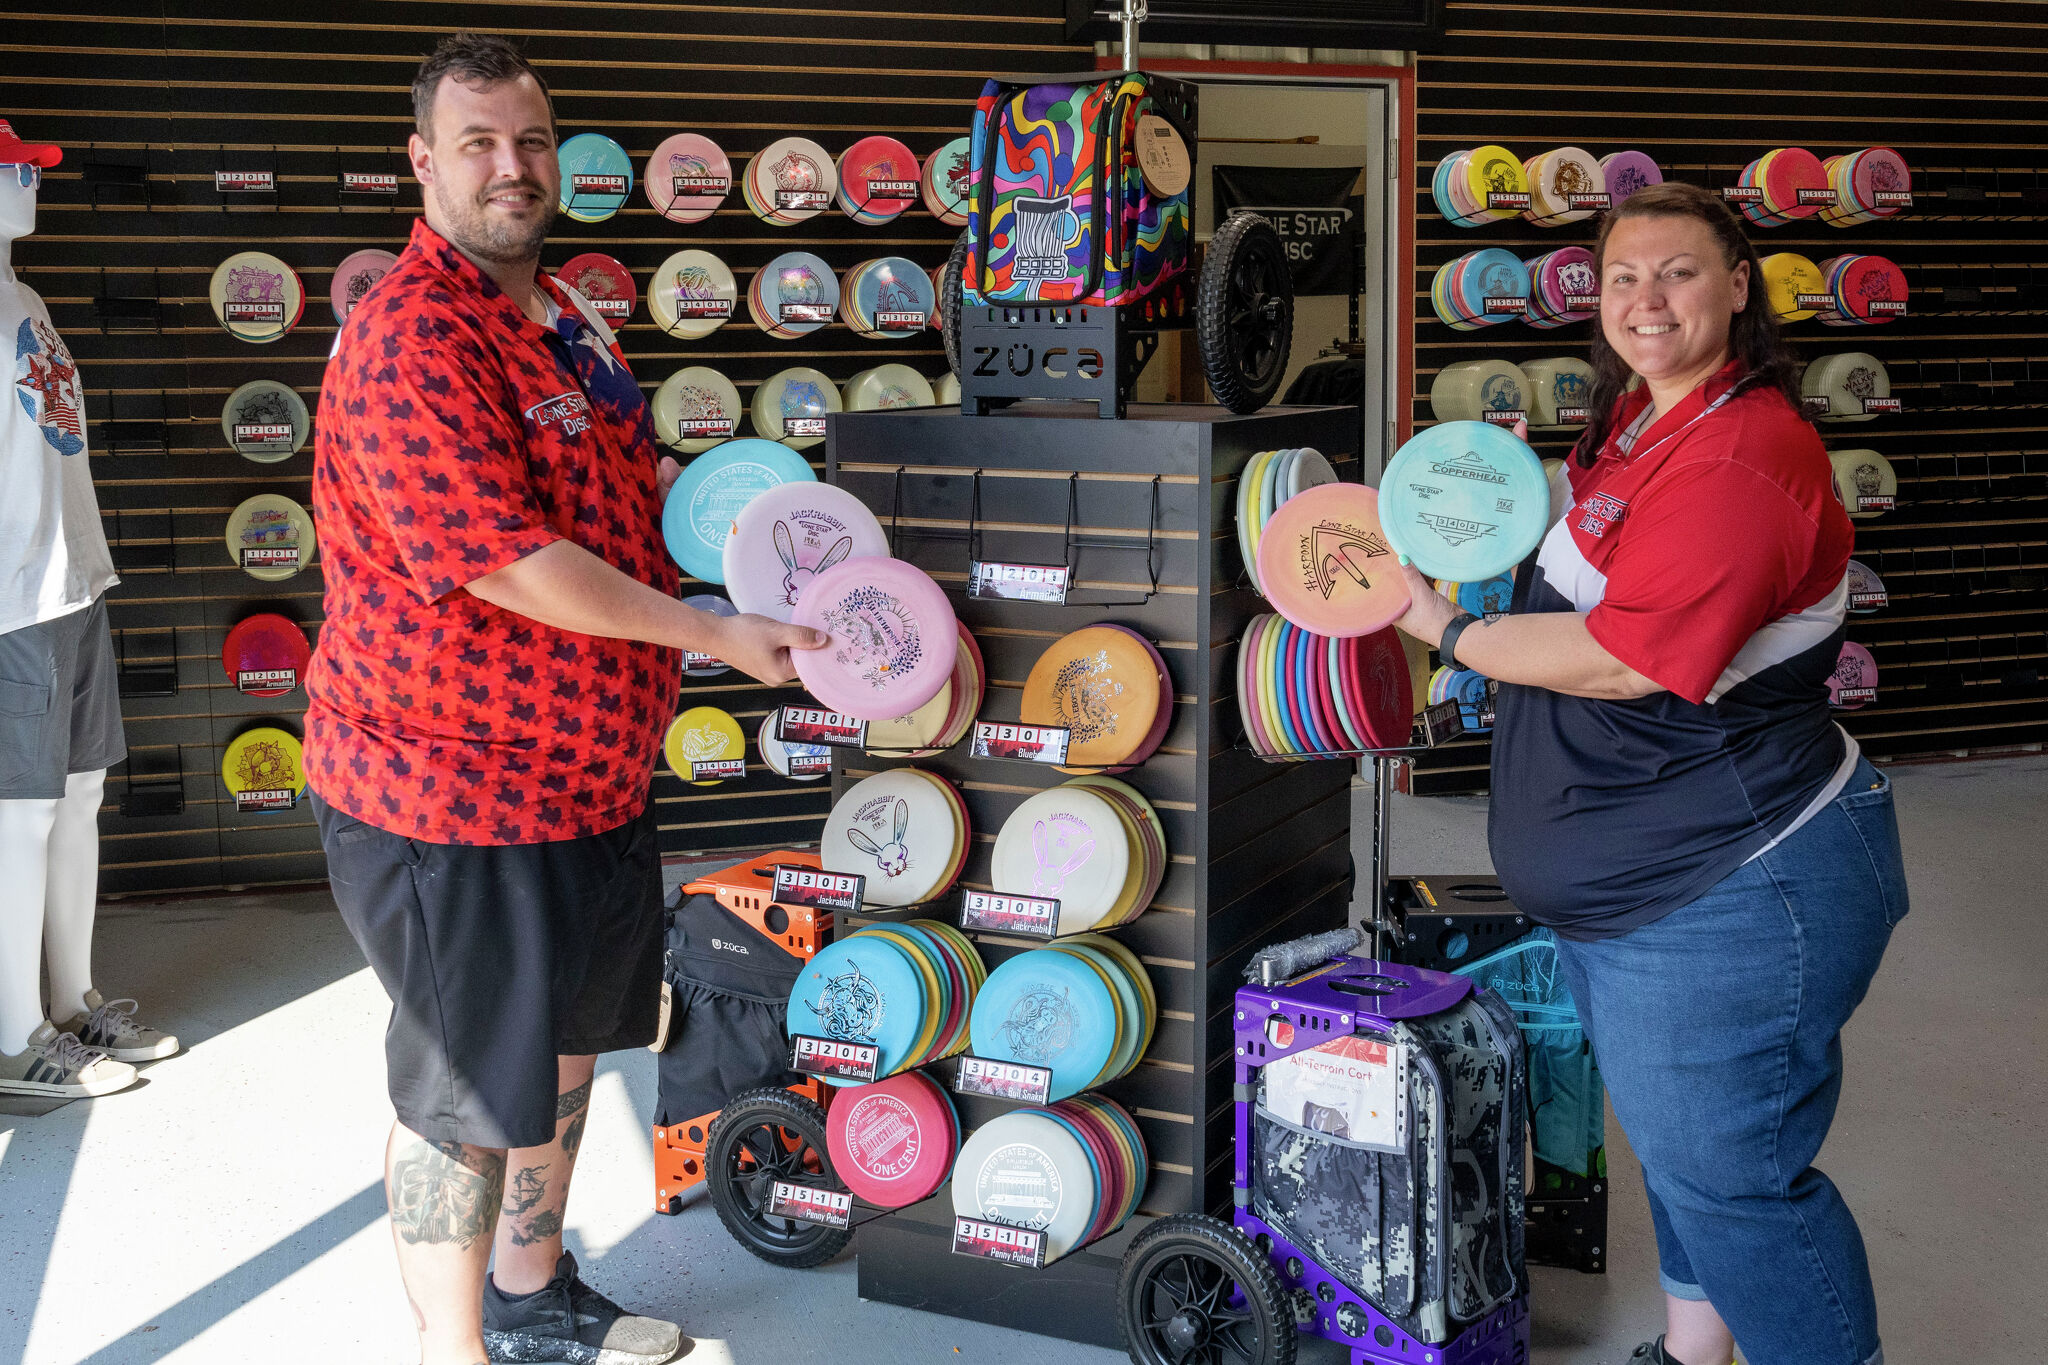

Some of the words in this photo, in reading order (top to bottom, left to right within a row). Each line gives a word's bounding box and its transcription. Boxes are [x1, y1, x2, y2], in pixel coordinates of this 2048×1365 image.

[1295, 213, 1341, 235] STAR
[1284, 241, 1313, 260] ISC
[563, 416, 590, 436] DISC
[1432, 464, 1506, 483] COPPERHEAD
[695, 477, 720, 505] UNITED
[720, 466, 752, 478] STATES
[1427, 487, 1440, 495] STAR
[789, 509, 847, 532] JACKRABBIT
[816, 525, 829, 533] STAR
[1578, 513, 1605, 538] DISC
[700, 522, 727, 544] ONE
[1344, 524, 1367, 537] STAR
[272, 559, 299, 567] Armadillo
[1300, 534, 1319, 592] HARPOON
[266, 679, 294, 687] Armadillo
[824, 731, 860, 744] Bluebonnet
[263, 799, 290, 807] Armadillo
[852, 795, 895, 823] JACKRABBIT
[817, 894, 853, 908] Jackrabbit
[1011, 919, 1049, 934] Jackrabbit
[839, 1065, 851, 1075] Bull
[852, 1068, 872, 1079] Snake
[1290, 1055, 1344, 1076] All-Terrain
[1348, 1067, 1372, 1080] Cart
[1008, 1087, 1021, 1099] Bull
[1023, 1089, 1043, 1102] Snake
[851, 1102, 870, 1126] STATES
[879, 1098, 909, 1118] AMERICA
[849, 1126, 861, 1158] UNITED
[873, 1162, 898, 1176] ONE
[897, 1137, 917, 1169] CENT
[980, 1156, 998, 1188] UNITED
[998, 1147, 1027, 1160] STATES
[1037, 1156, 1059, 1193] AMERICA
[806, 1208, 825, 1223] Penny
[826, 1211, 847, 1226] Putter
[991, 1246, 1011, 1262] Penny
[1013, 1249, 1035, 1265] Putter
